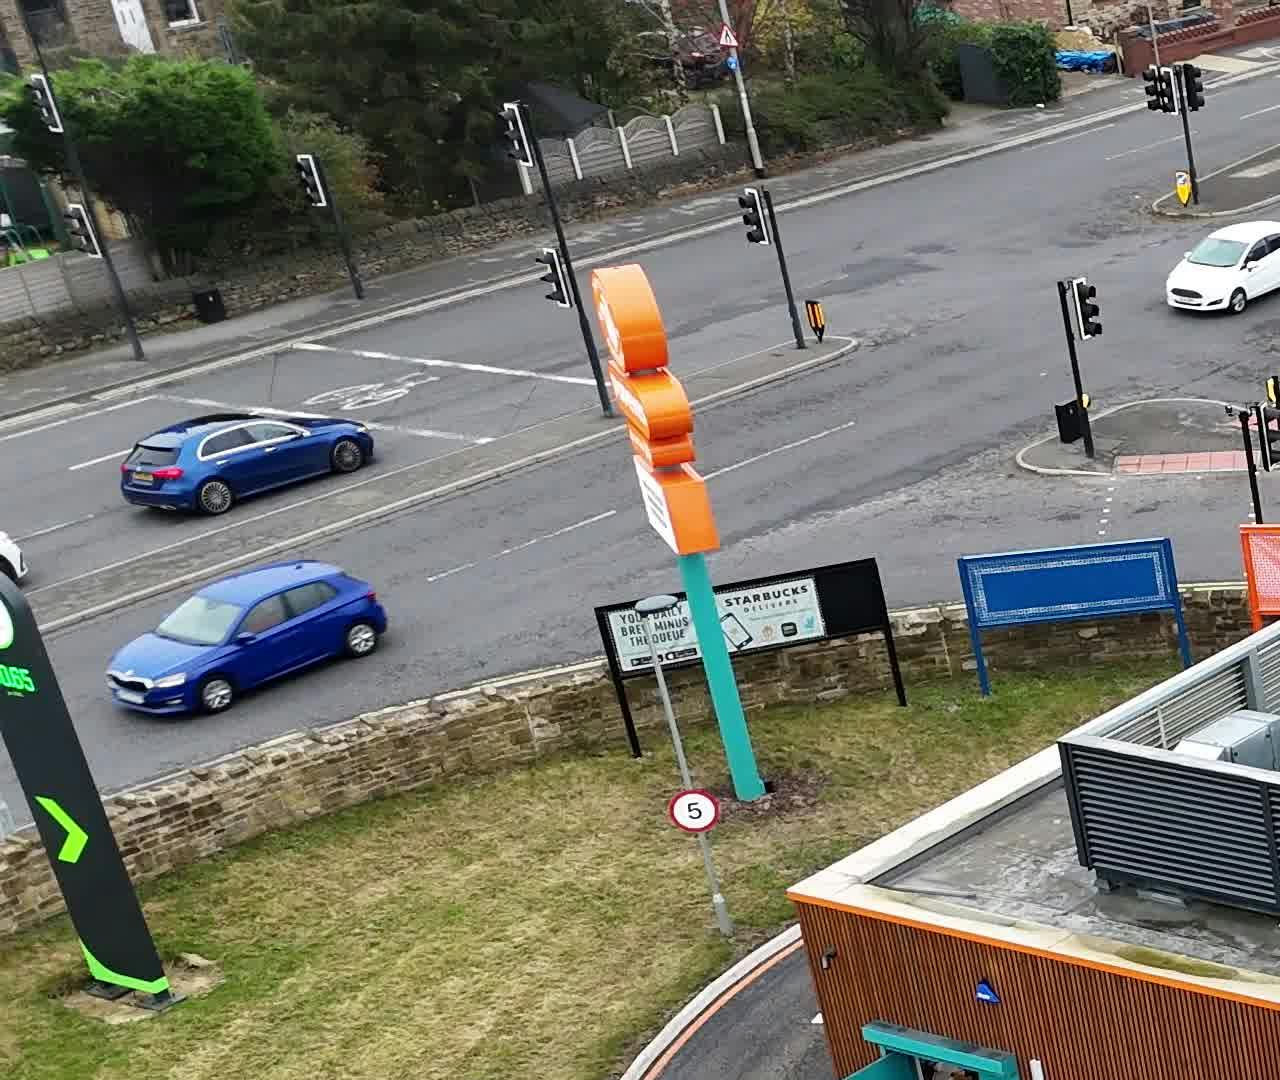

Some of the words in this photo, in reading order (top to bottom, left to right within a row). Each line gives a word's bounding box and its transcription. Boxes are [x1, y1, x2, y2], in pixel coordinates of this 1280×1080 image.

[724, 585, 809, 607] STARBUCKS
[620, 611, 650, 625] YOU
[654, 616, 689, 632] MINUS
[652, 629, 687, 644] QUEUE
[688, 802, 702, 820] 5
